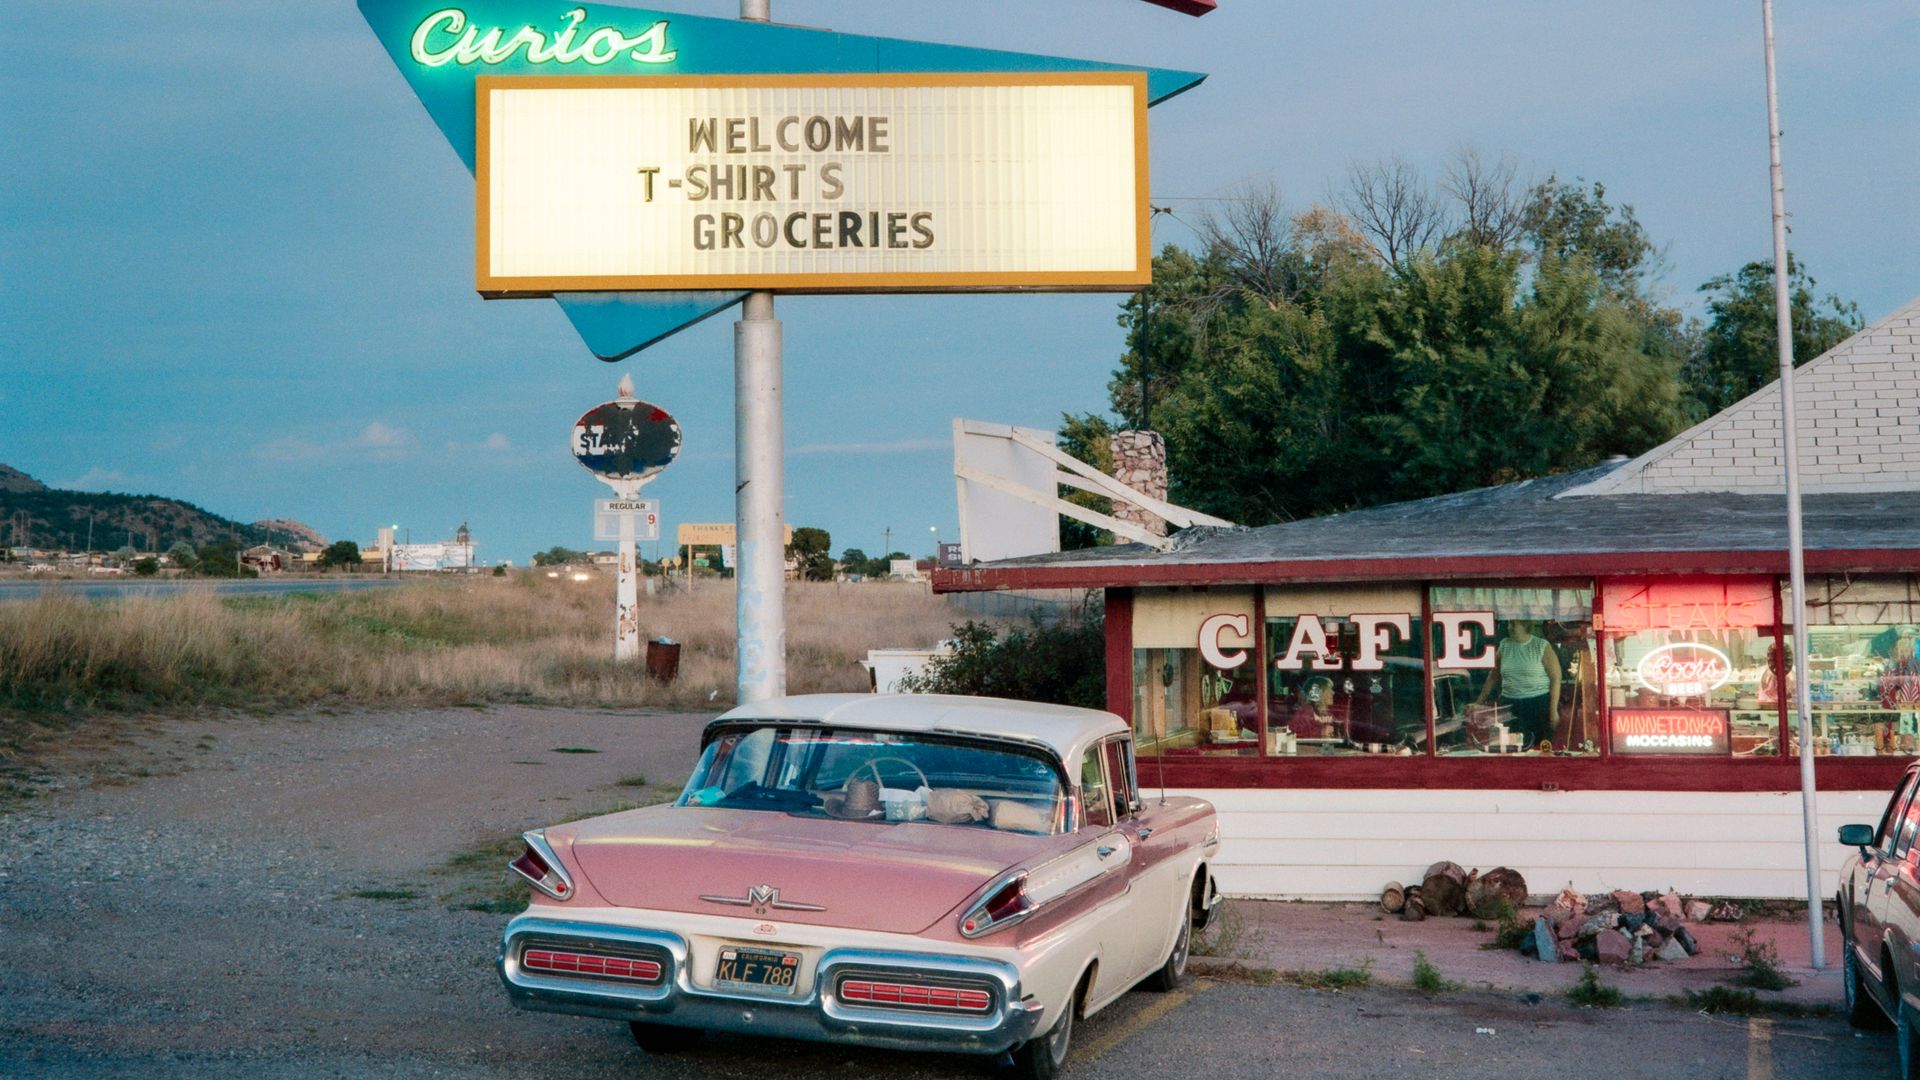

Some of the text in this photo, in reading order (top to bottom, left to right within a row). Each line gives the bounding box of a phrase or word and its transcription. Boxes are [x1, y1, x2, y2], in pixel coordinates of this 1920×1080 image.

[410, 7, 679, 67] Curios
[688, 115, 890, 154] WELCOME
[693, 211, 935, 250] GROCERIES
[609, 502, 646, 510] REGULAR
[648, 513, 656, 525] 9
[1619, 601, 1759, 629] STEAKS
[1198, 611, 1496, 671] CAFE
[1650, 655, 1721, 681] Coors
[1667, 683, 1703, 695] BEER
[1616, 715, 1723, 734] MINNETONKA
[1626, 734, 1713, 748] MOCCASINS
[741, 953, 779, 963] CALIFORNIA
[719, 961, 758, 982] KLF
[762, 965, 793, 986] 788
